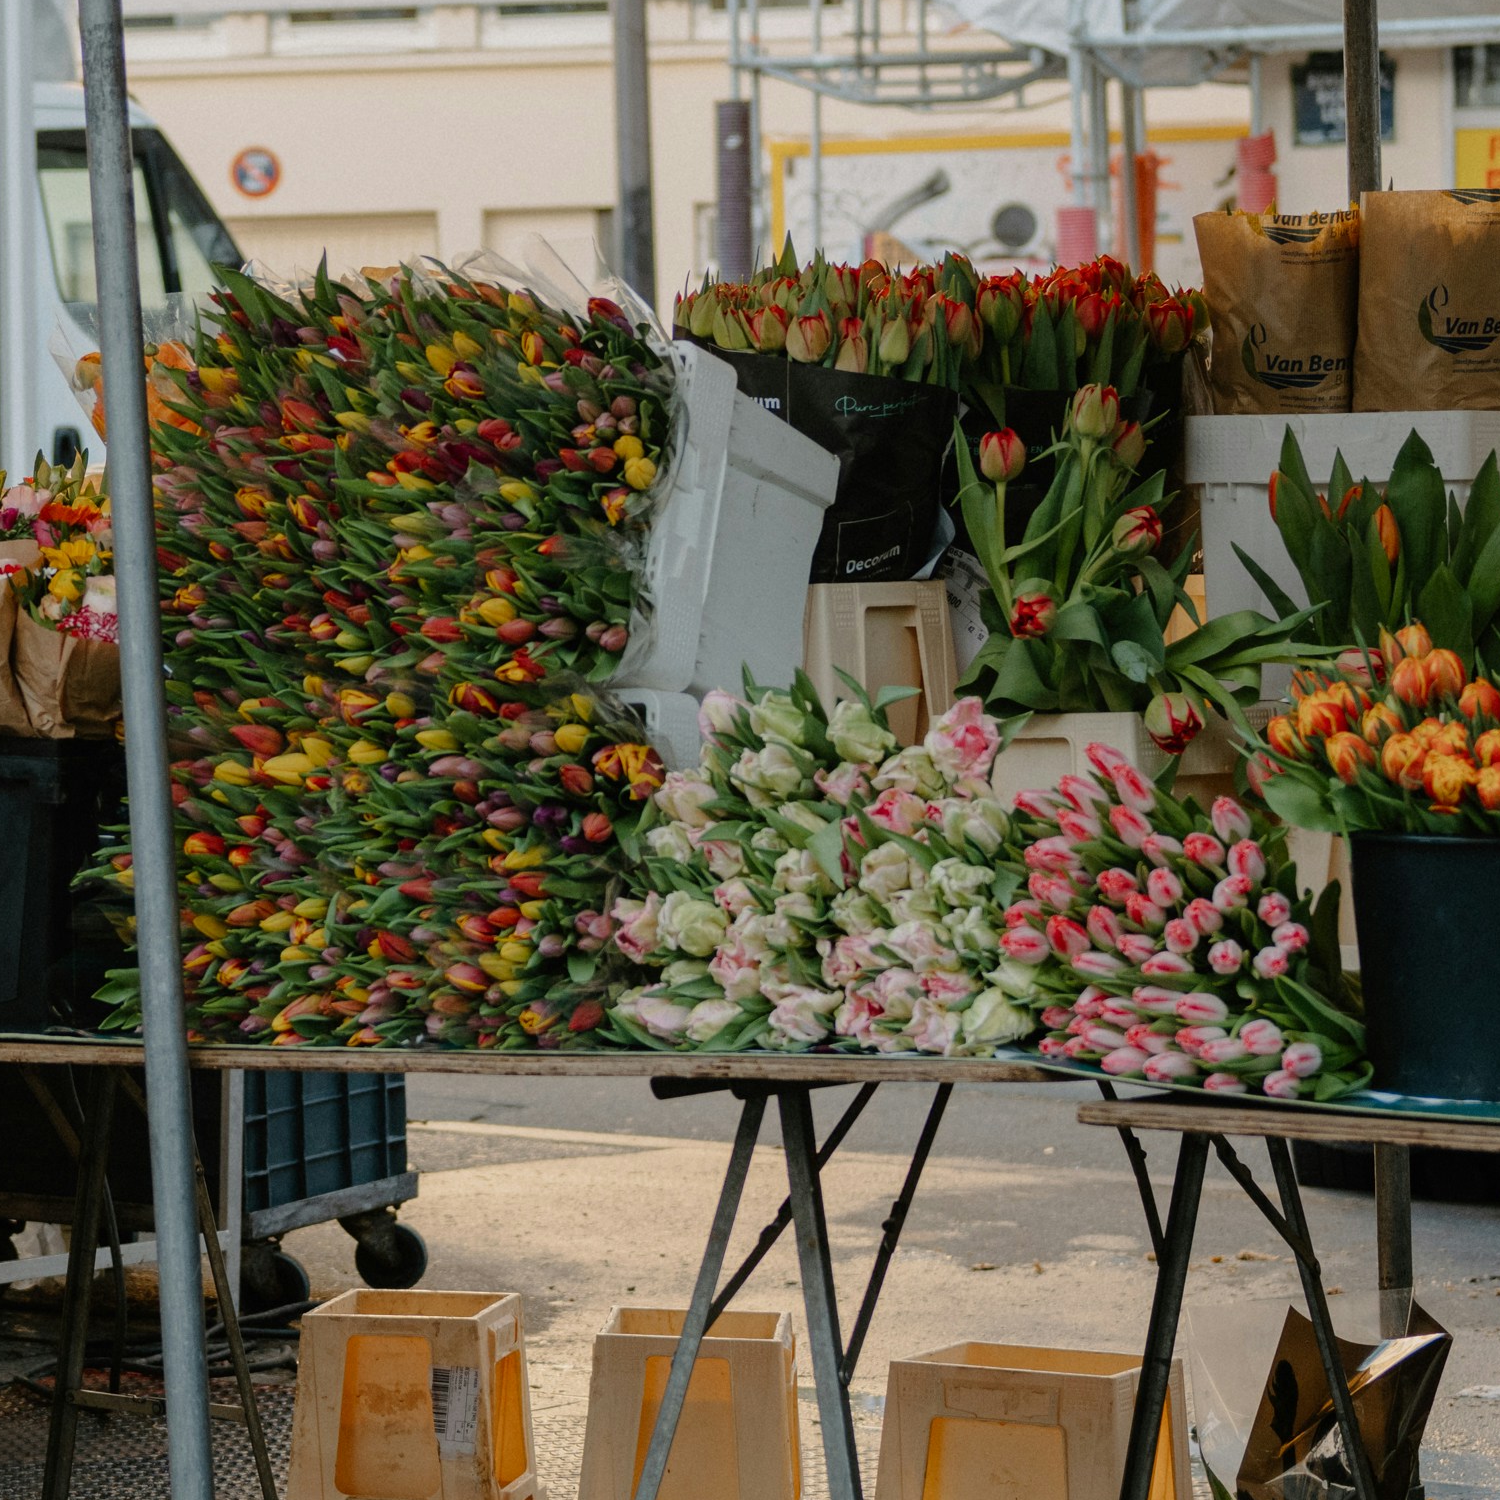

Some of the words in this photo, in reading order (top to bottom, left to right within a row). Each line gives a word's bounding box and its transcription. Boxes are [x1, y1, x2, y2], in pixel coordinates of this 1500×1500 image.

[1445, 316, 1480, 336] Van
[1265, 354, 1302, 374] Van
[834, 396, 881, 418] Pure
[845, 543, 901, 575] Decorum
